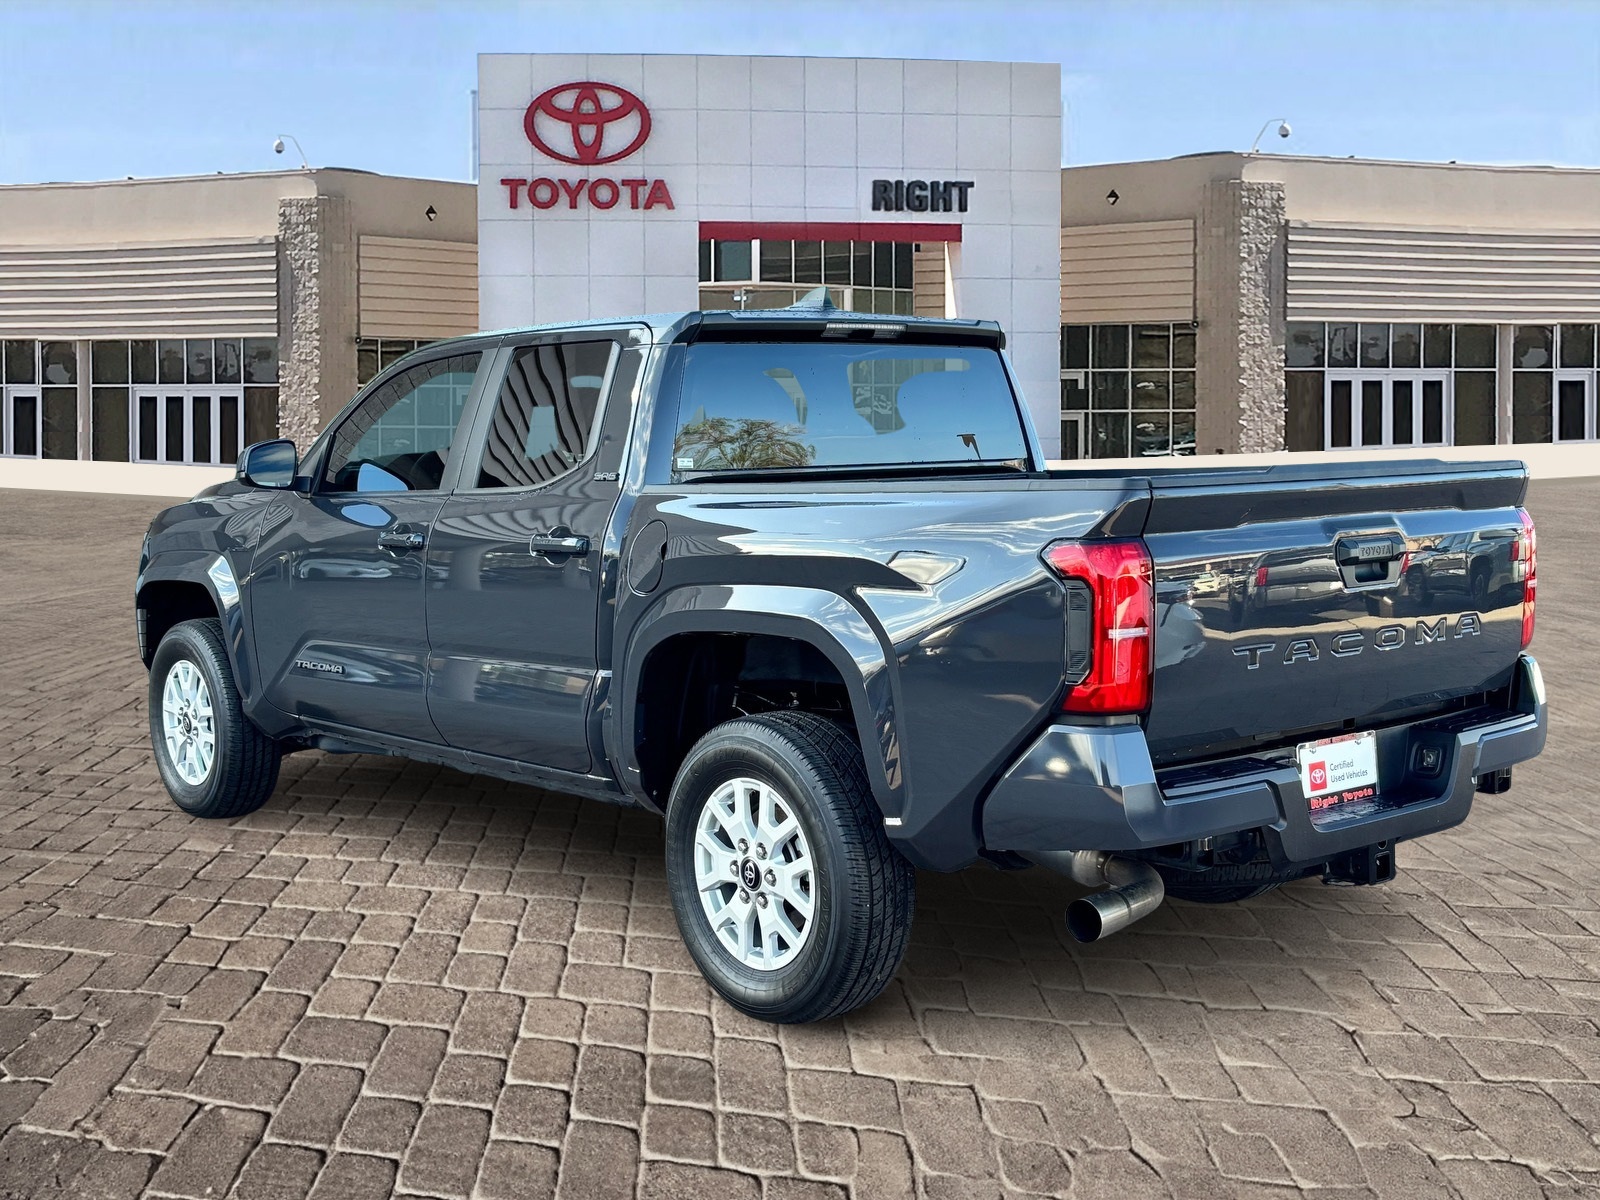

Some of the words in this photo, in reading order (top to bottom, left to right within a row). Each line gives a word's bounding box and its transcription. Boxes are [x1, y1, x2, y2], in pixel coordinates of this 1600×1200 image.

[500, 178, 675, 210] TOYOTA
[872, 180, 974, 213] RIGHT
[1360, 545, 1391, 557] TOYOTA
[1231, 611, 1482, 670] TACOMA
[295, 659, 343, 674] TACOMA
[1329, 759, 1354, 771] Certified
[1330, 774, 1345, 783] Used
[1346, 769, 1368, 779] Vehicles
[1310, 795, 1339, 809] Right
[1342, 787, 1374, 802] Toyota
